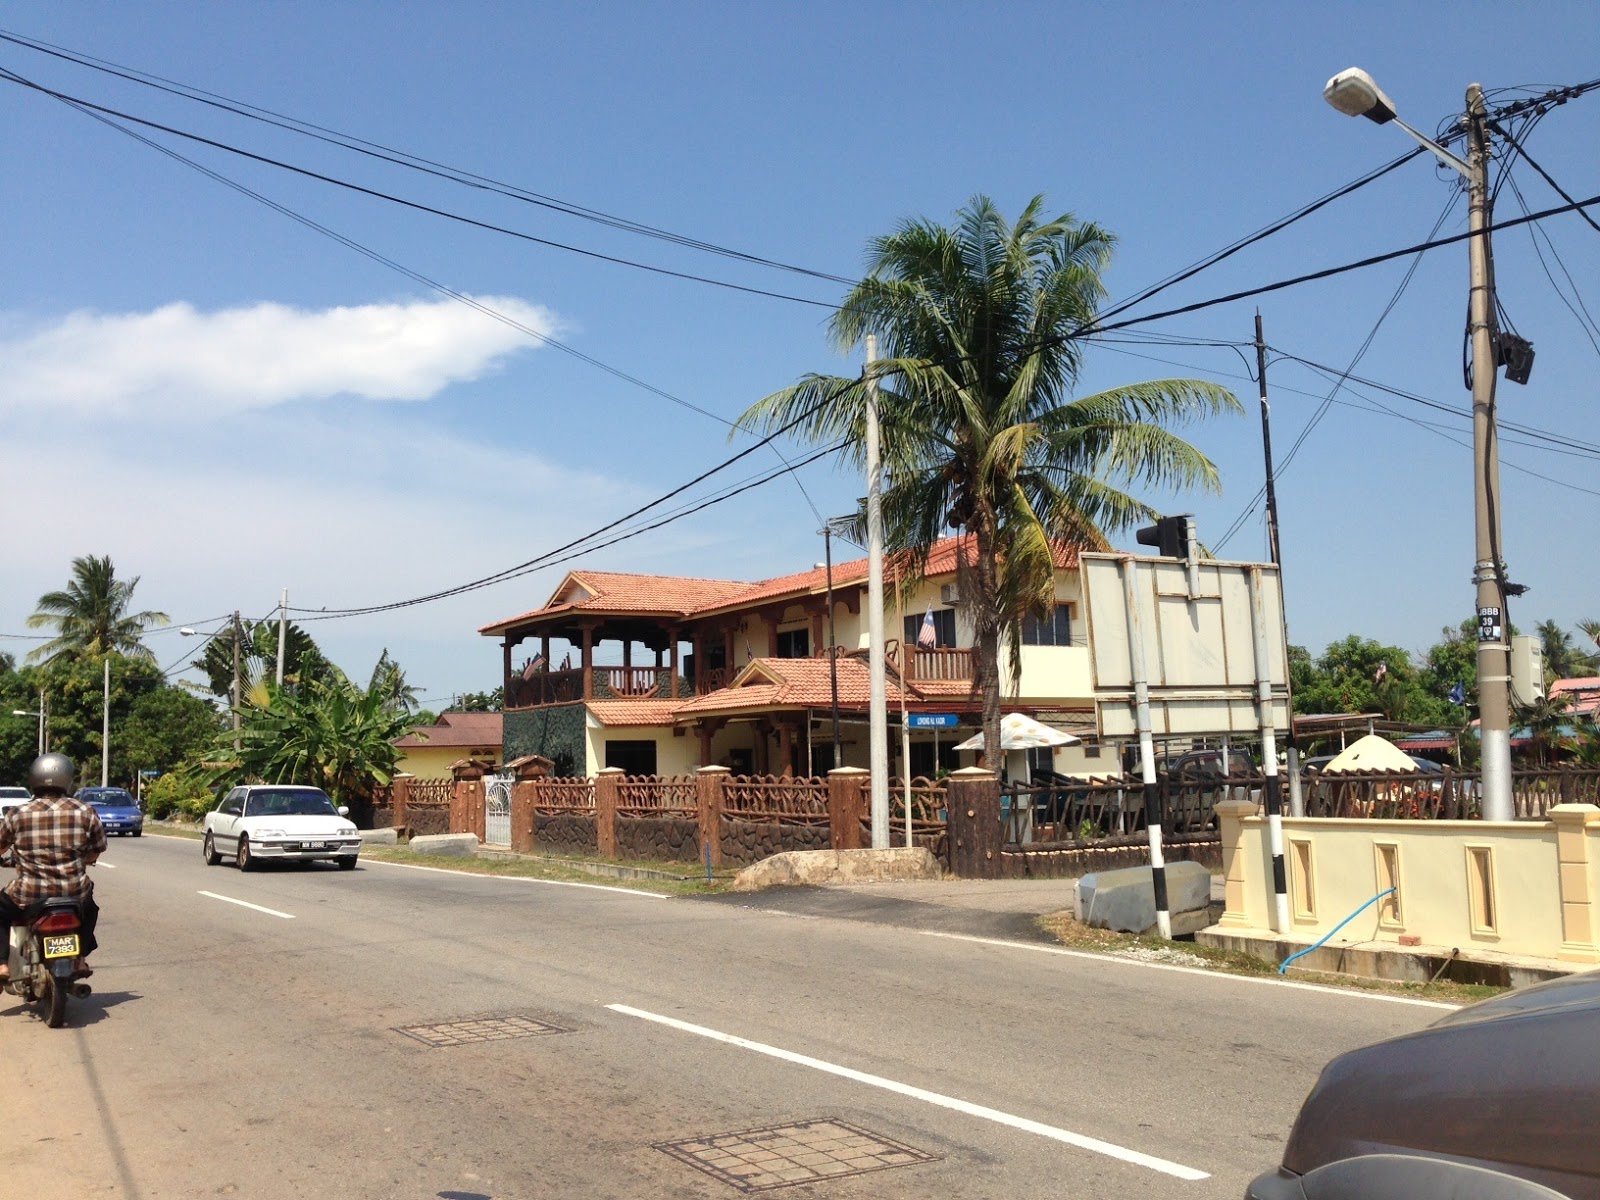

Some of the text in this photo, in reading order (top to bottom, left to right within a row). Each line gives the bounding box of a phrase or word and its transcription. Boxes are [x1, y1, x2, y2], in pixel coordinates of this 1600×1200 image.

[1482, 617, 1493, 626] 39
[51, 938, 71, 946] MAR
[49, 945, 74, 954] 7383
